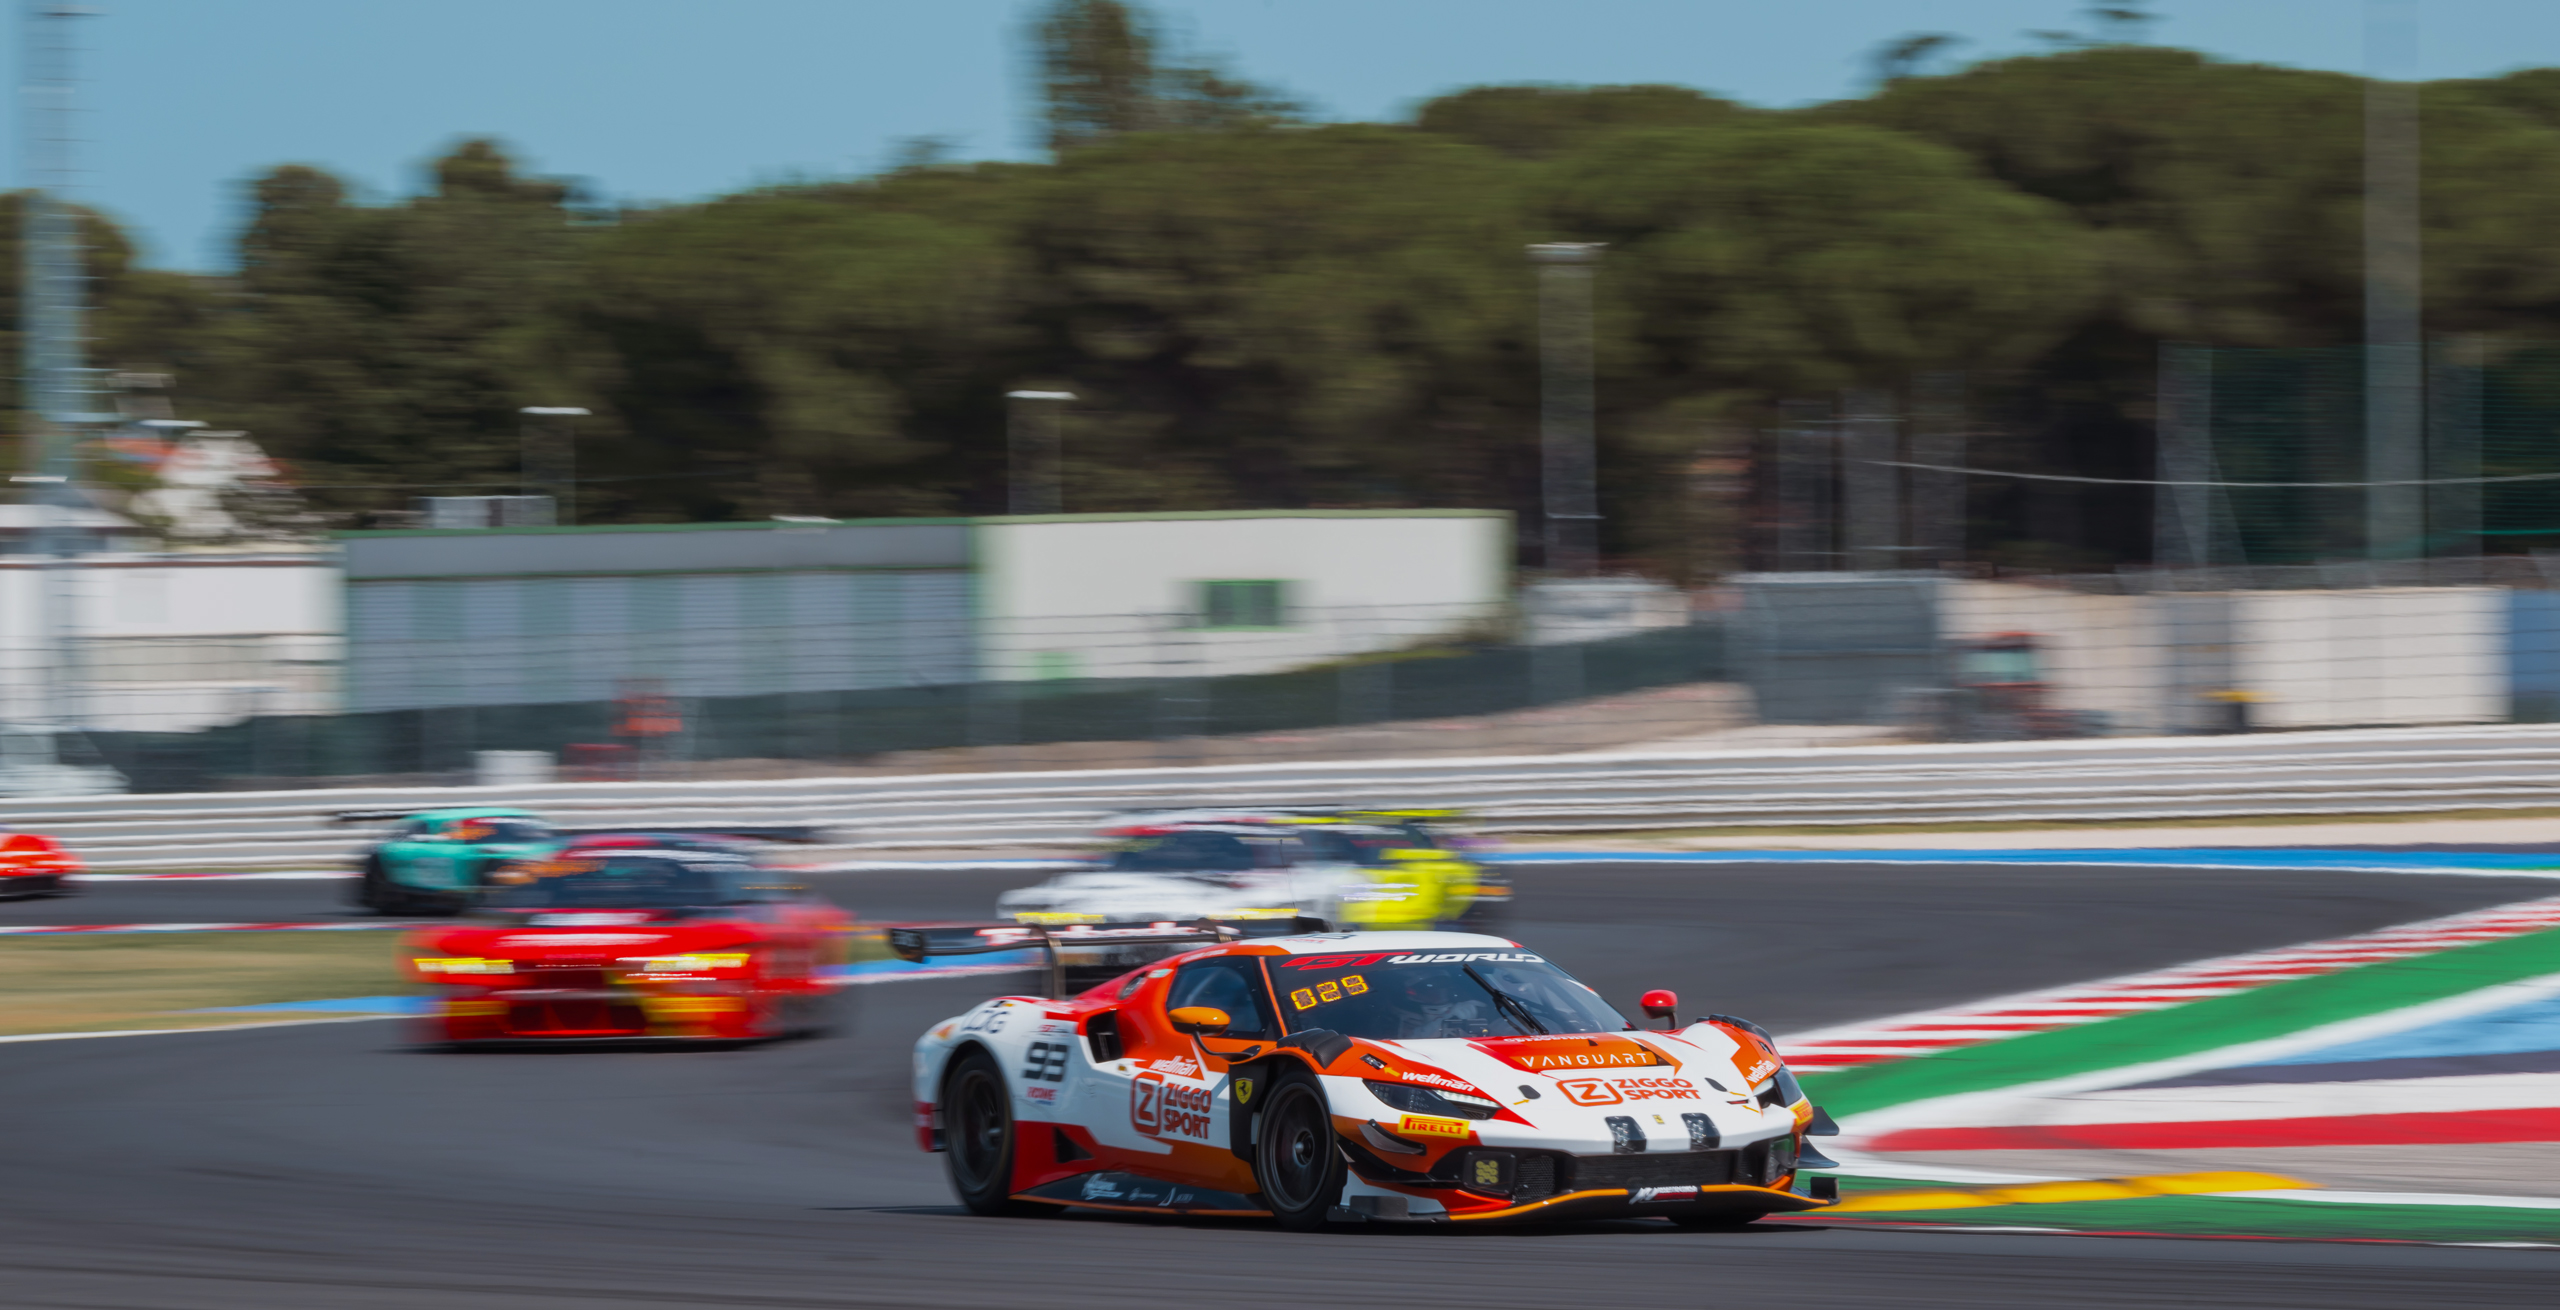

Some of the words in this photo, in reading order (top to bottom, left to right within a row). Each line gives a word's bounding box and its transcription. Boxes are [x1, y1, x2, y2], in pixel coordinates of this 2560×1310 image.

[1387, 953, 1545, 964] WORLD
[1290, 974, 1369, 1010] 029
[1023, 1041, 1070, 1083] 93
[1521, 1053, 1648, 1067] VANGUART
[1611, 1078, 1693, 1089] ZIGGO
[1164, 1083, 1212, 1114] ZIGGO
[1623, 1089, 1701, 1101] SPORT
[1163, 1108, 1211, 1140] SPORT
[1404, 1117, 1464, 1135] PIRELLI
